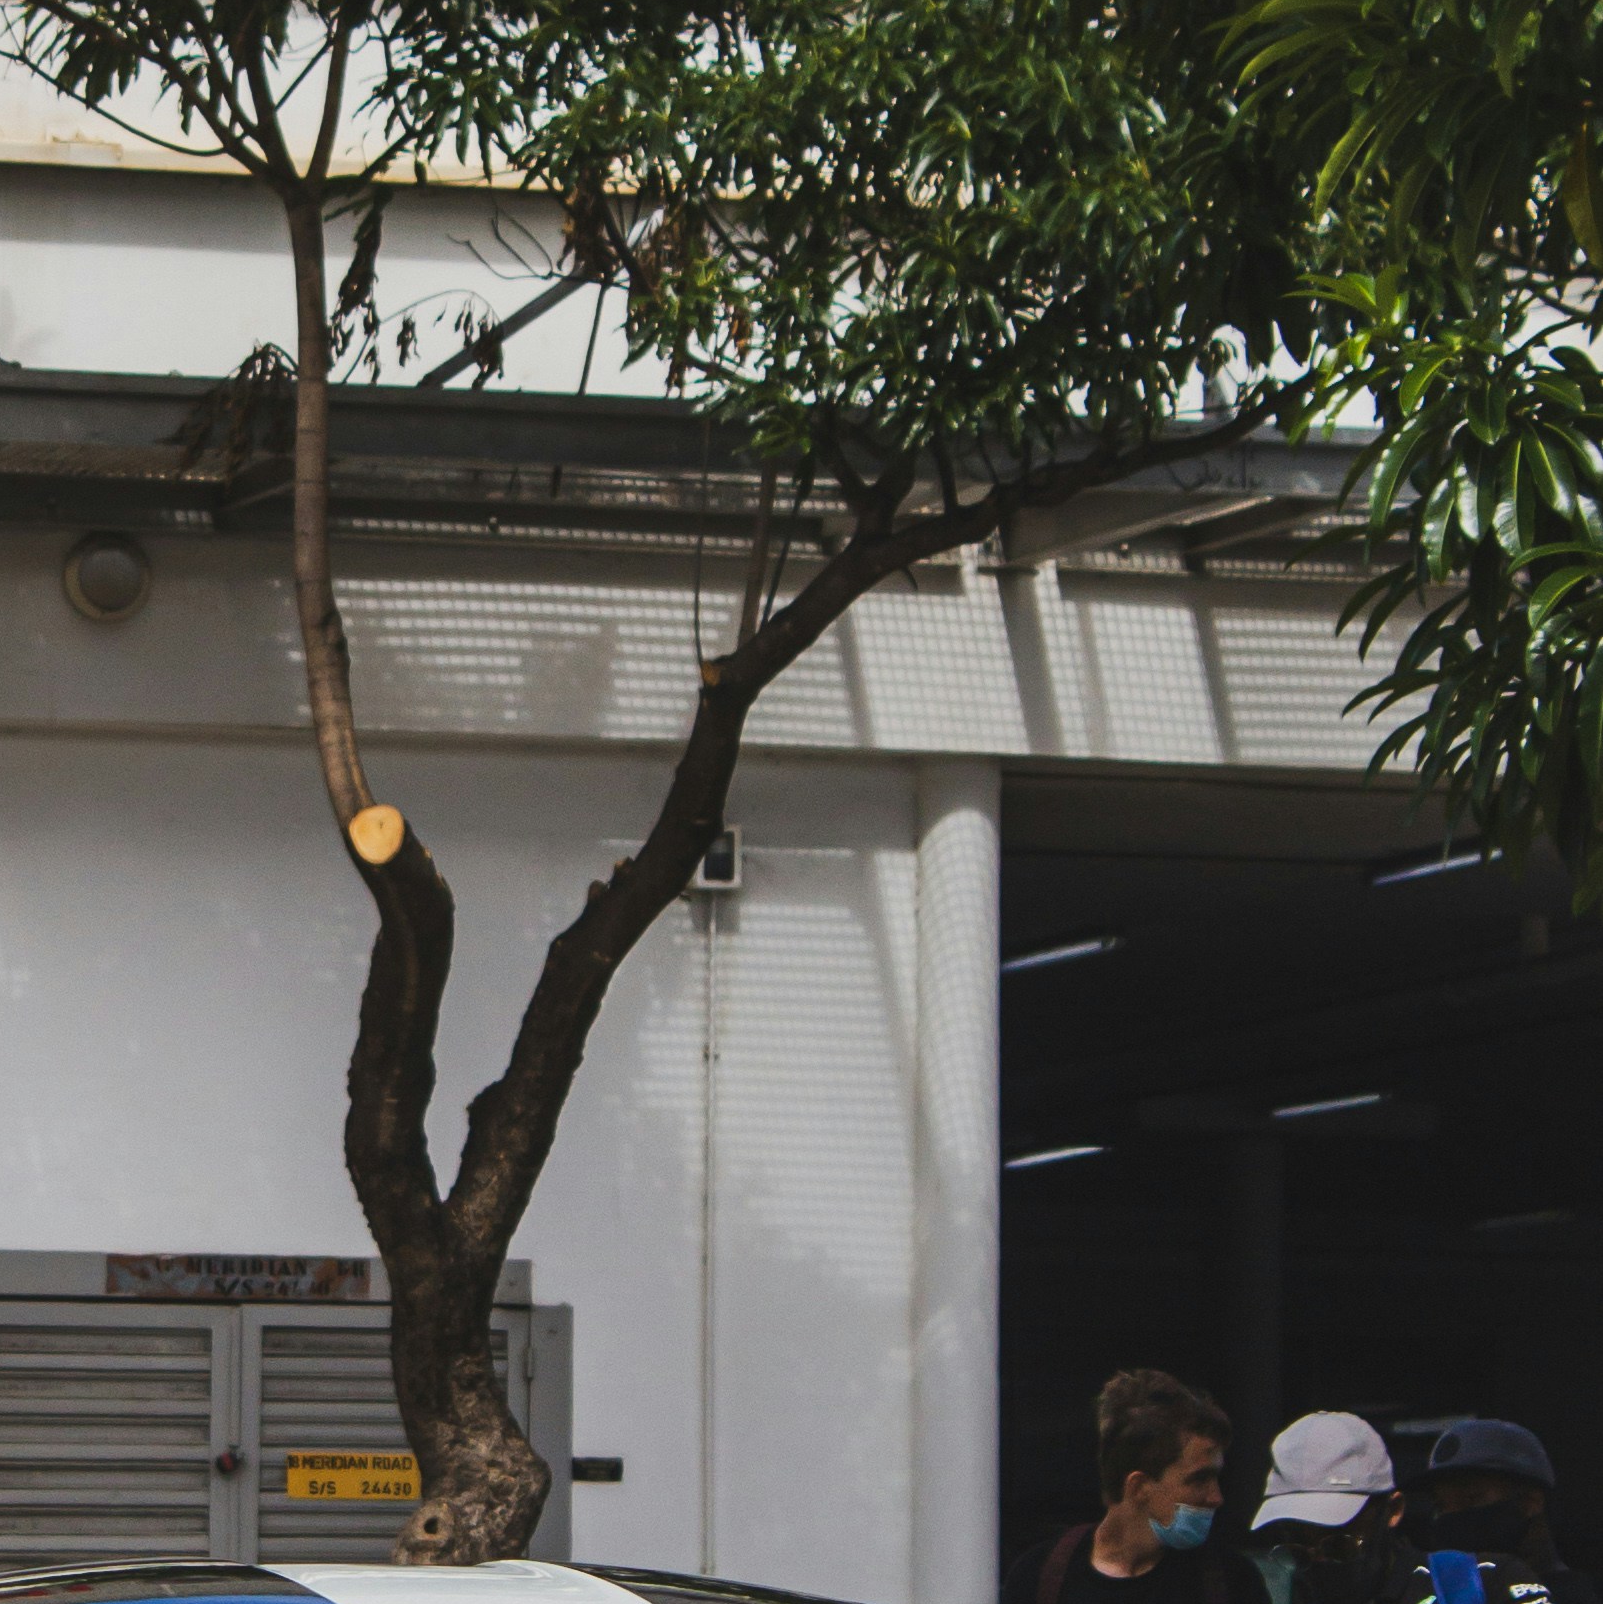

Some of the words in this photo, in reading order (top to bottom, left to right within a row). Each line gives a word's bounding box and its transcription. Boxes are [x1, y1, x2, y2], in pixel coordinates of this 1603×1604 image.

[302, 1455, 368, 1470] MERIDIAN
[372, 1456, 413, 1470] ROAD
[309, 1481, 336, 1495] S/S
[361, 1481, 412, 1495] 24430
